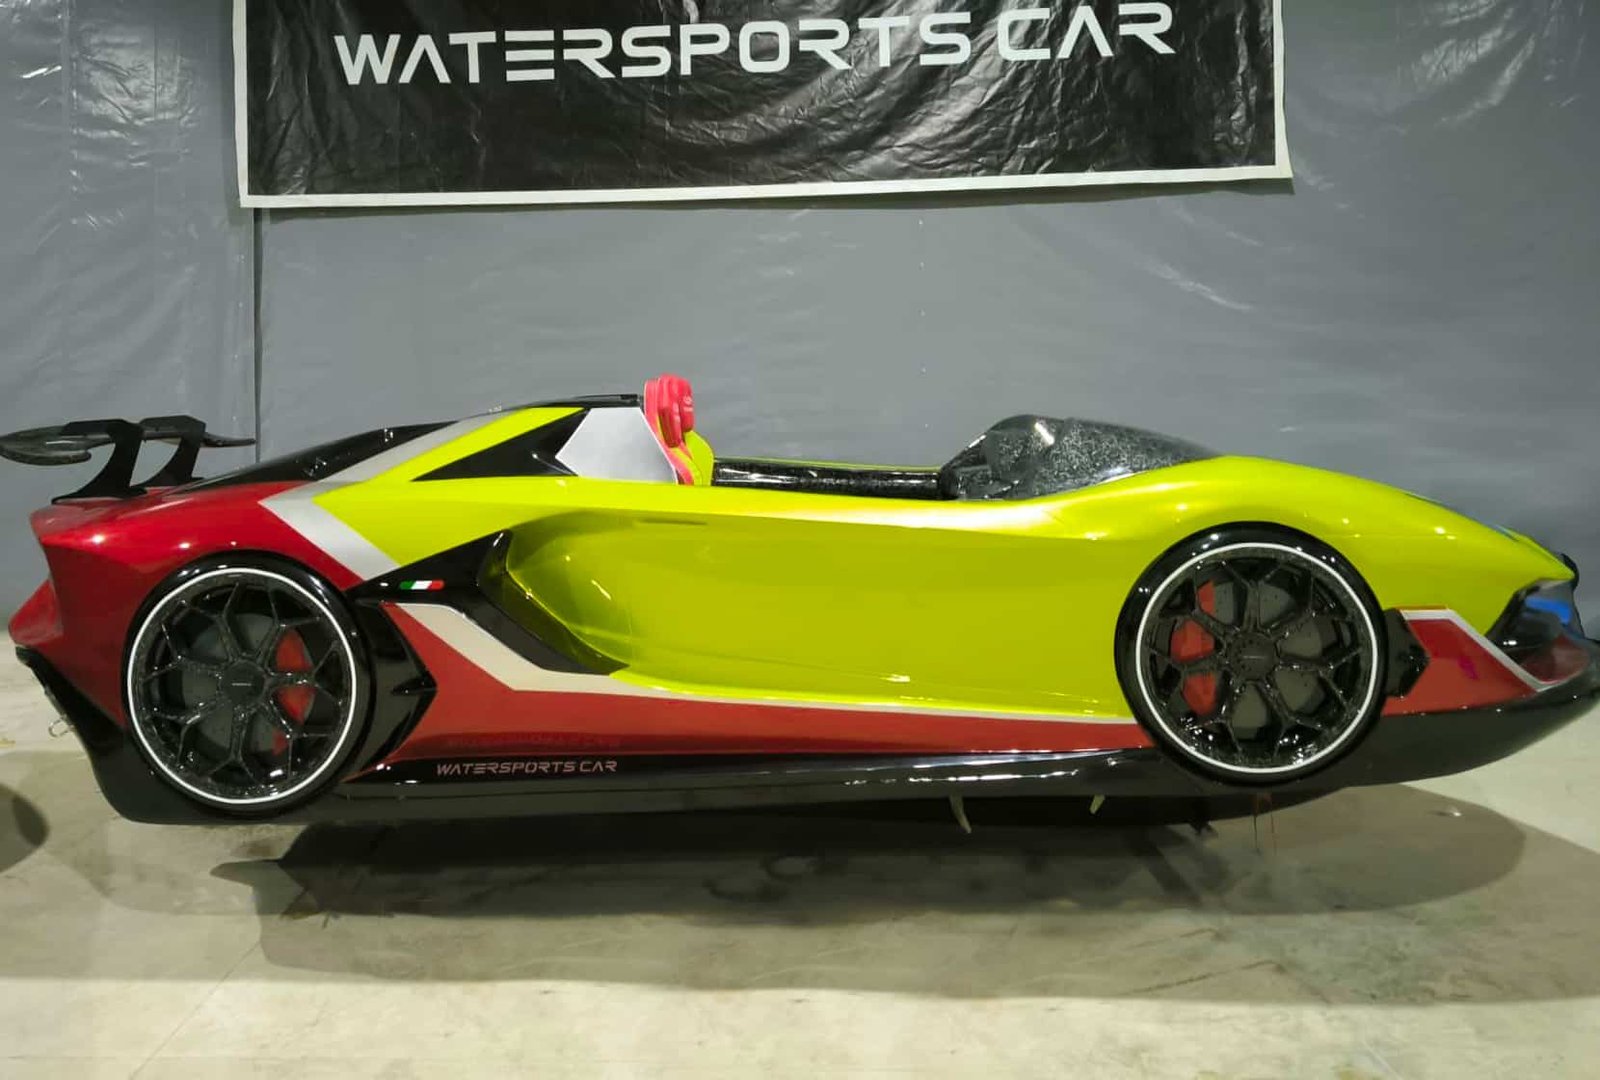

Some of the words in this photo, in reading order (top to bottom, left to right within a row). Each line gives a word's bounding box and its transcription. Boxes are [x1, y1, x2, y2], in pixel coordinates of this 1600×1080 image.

[334, 12, 972, 85] WATERSPORTS
[997, 2, 1176, 61] CAR
[436, 761, 577, 776] WATERSPORTS
[579, 760, 618, 773] CAR
